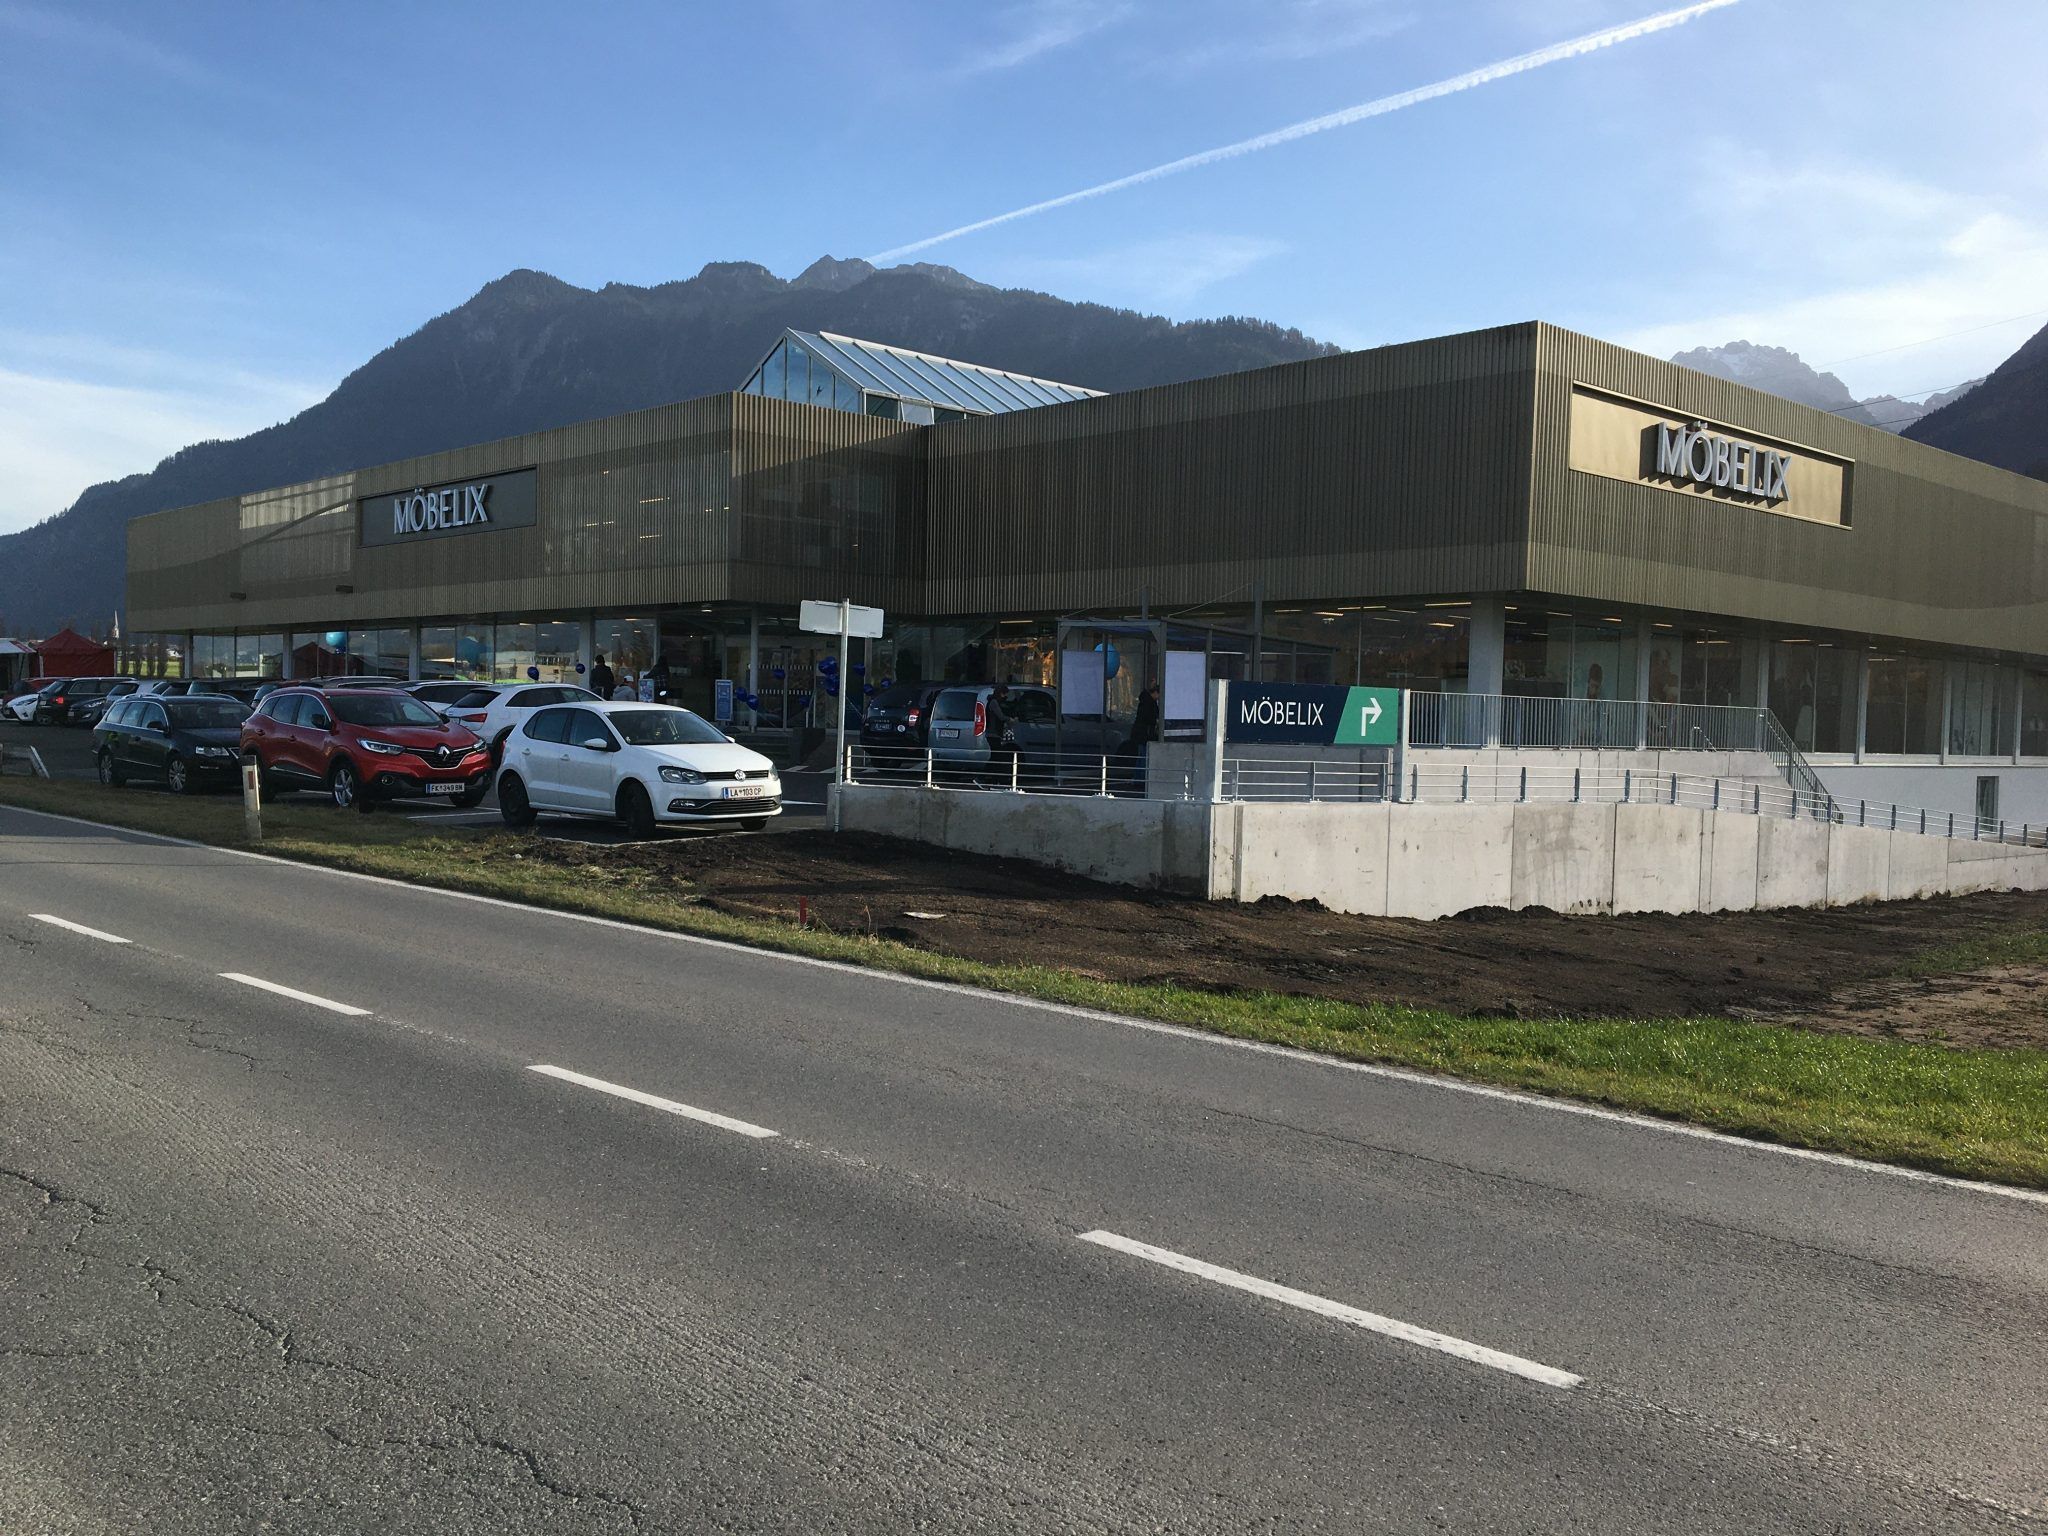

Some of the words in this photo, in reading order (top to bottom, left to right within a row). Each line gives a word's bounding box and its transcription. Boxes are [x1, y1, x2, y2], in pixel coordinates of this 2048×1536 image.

[1656, 420, 1791, 501] MÖBELIX
[394, 483, 488, 534] MÖBELIX
[1241, 696, 1324, 726] MÖBELIX
